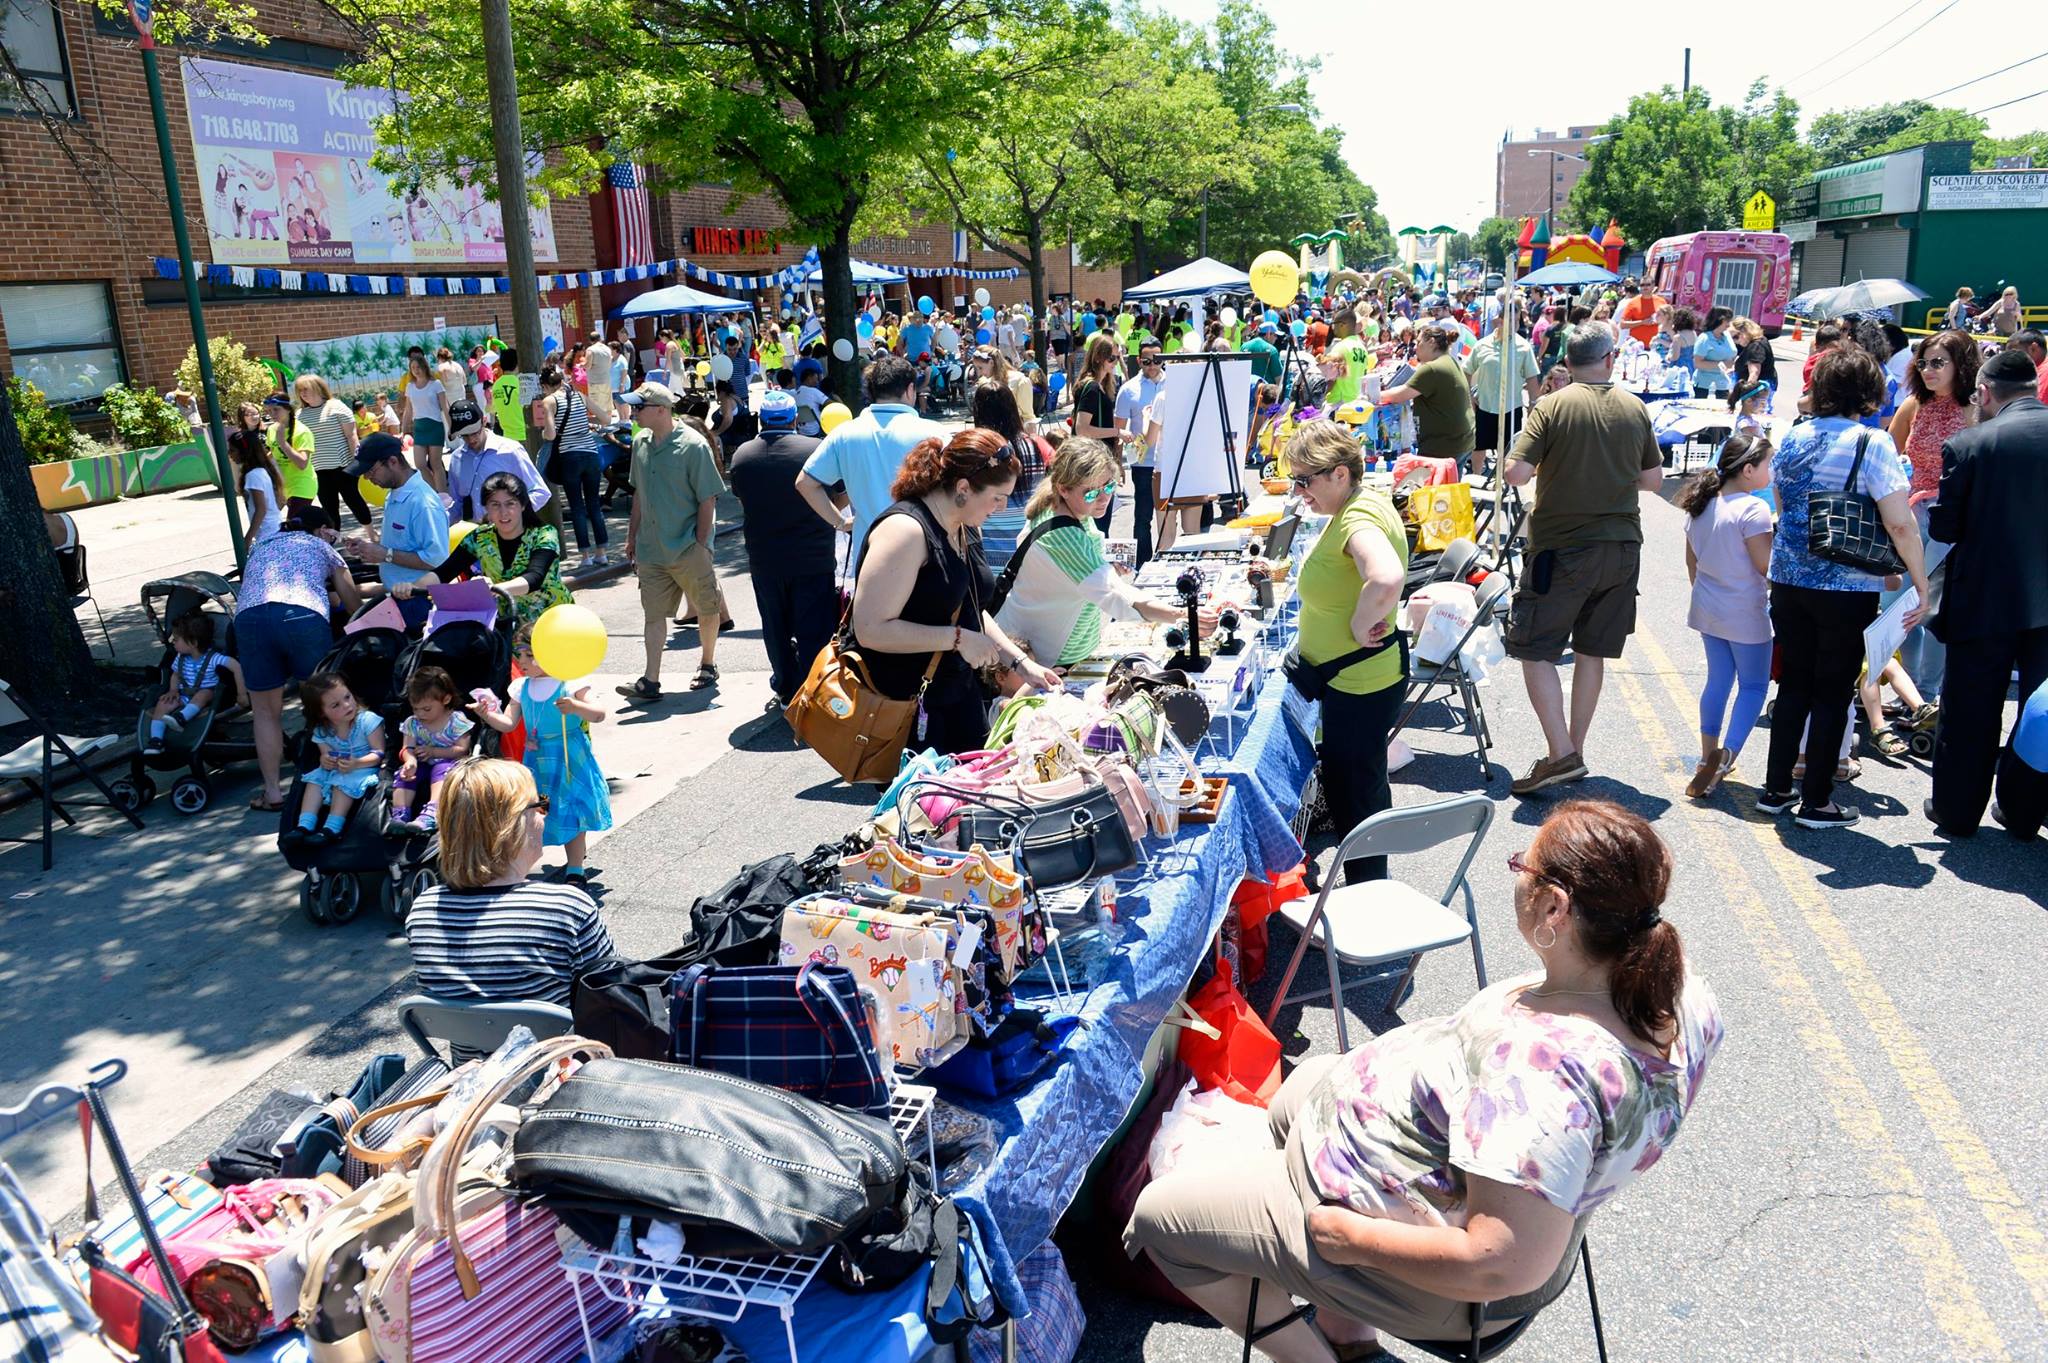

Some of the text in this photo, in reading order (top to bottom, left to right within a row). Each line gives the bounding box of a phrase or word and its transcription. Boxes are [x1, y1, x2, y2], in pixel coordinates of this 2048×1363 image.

[201, 115, 299, 144] 718.648.7703
[1932, 175, 1984, 187] SCIENTIFIC
[1987, 174, 2040, 185] DISCOVERY
[1746, 220, 1770, 228] AHEAD
[694, 226, 740, 256] KINGS
[891, 239, 931, 255] BUILDING
[290, 247, 320, 257] SUMMER
[320, 247, 333, 257] DAY
[334, 247, 352, 257] CAMP
